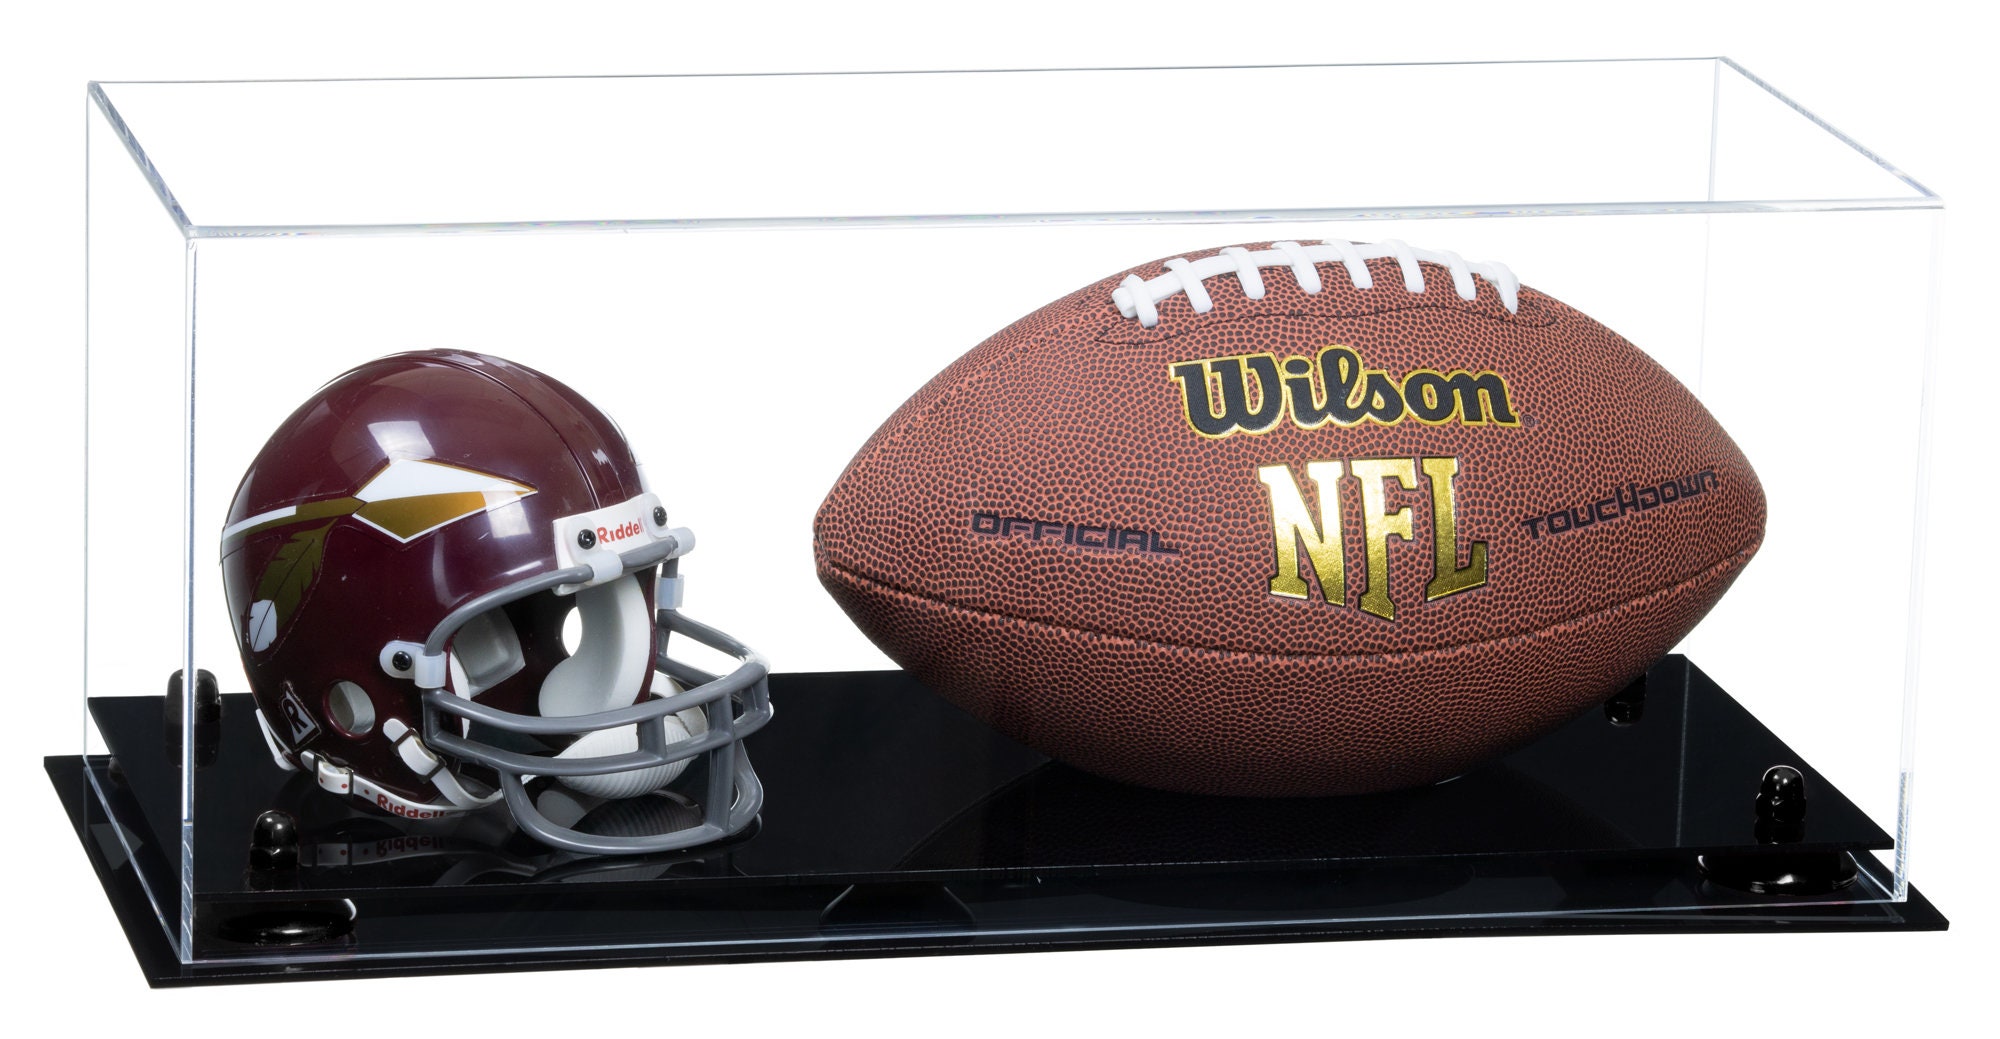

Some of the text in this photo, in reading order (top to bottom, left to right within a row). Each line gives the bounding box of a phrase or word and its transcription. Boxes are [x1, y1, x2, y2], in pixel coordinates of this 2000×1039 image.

[1168, 345, 1521, 440] Wilson
[596, 517, 645, 544] Riddel
[972, 512, 1181, 555] OFFICIAL
[1257, 456, 1489, 622] NFL
[376, 793, 445, 819] Riddell
